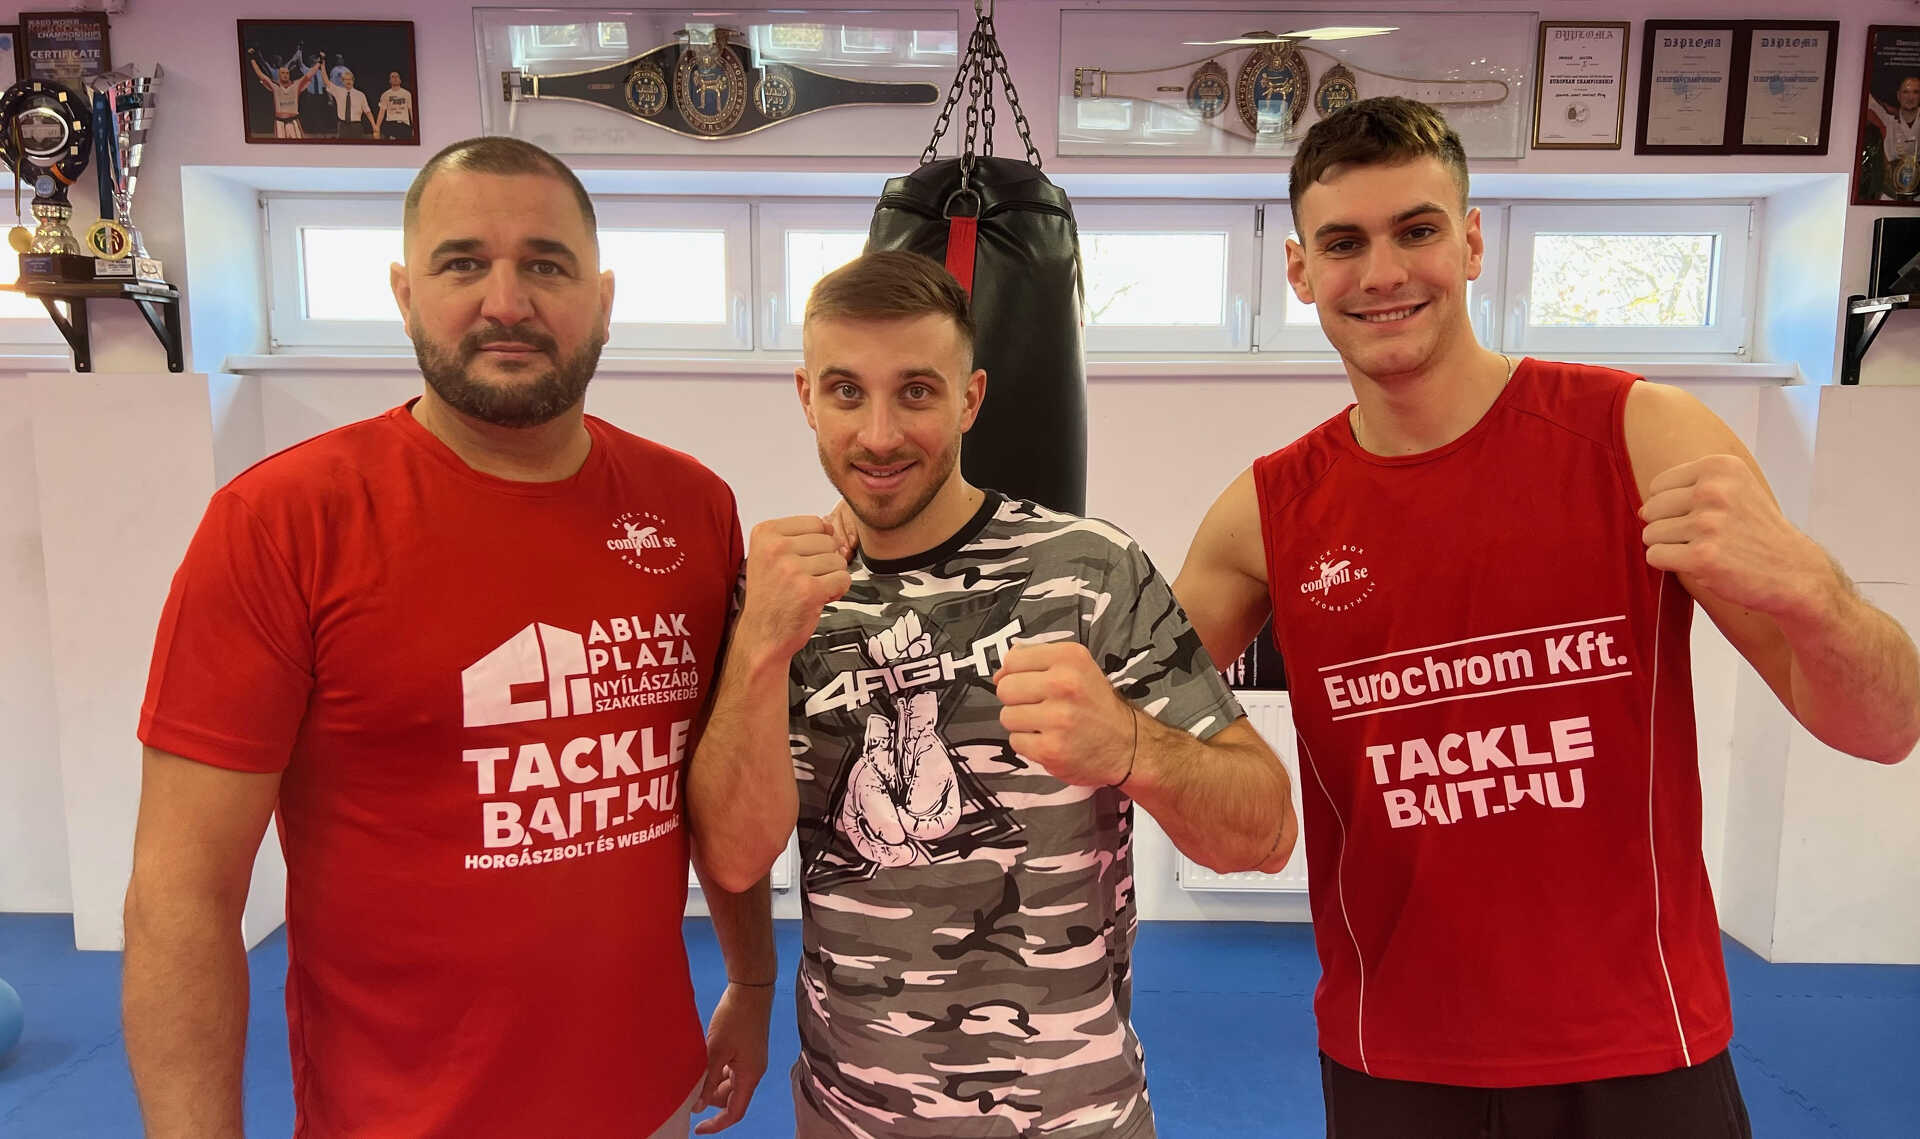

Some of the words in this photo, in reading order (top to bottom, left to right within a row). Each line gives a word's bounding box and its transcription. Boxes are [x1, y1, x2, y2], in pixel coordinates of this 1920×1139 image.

[30, 49, 101, 60] CERTIFICATE
[662, 536, 678, 548] se
[1353, 567, 1369, 581] se
[588, 613, 691, 645] ABLAK
[588, 640, 697, 676] PLAZA
[1323, 648, 1534, 711] Eurochrom
[1544, 630, 1628, 676] Kft.
[593, 667, 700, 699] NYÍLÁSZÁRÓ
[595, 688, 699, 713] SZAKKERESKEDÉS
[462, 719, 691, 795] TACKLE
[1365, 715, 1595, 785] TACKLE
[464, 841, 594, 870] HORGÁSZBOLT
[596, 834, 616, 855] ÉS
[616, 814, 681, 850] WEBÁRUHÁZ
